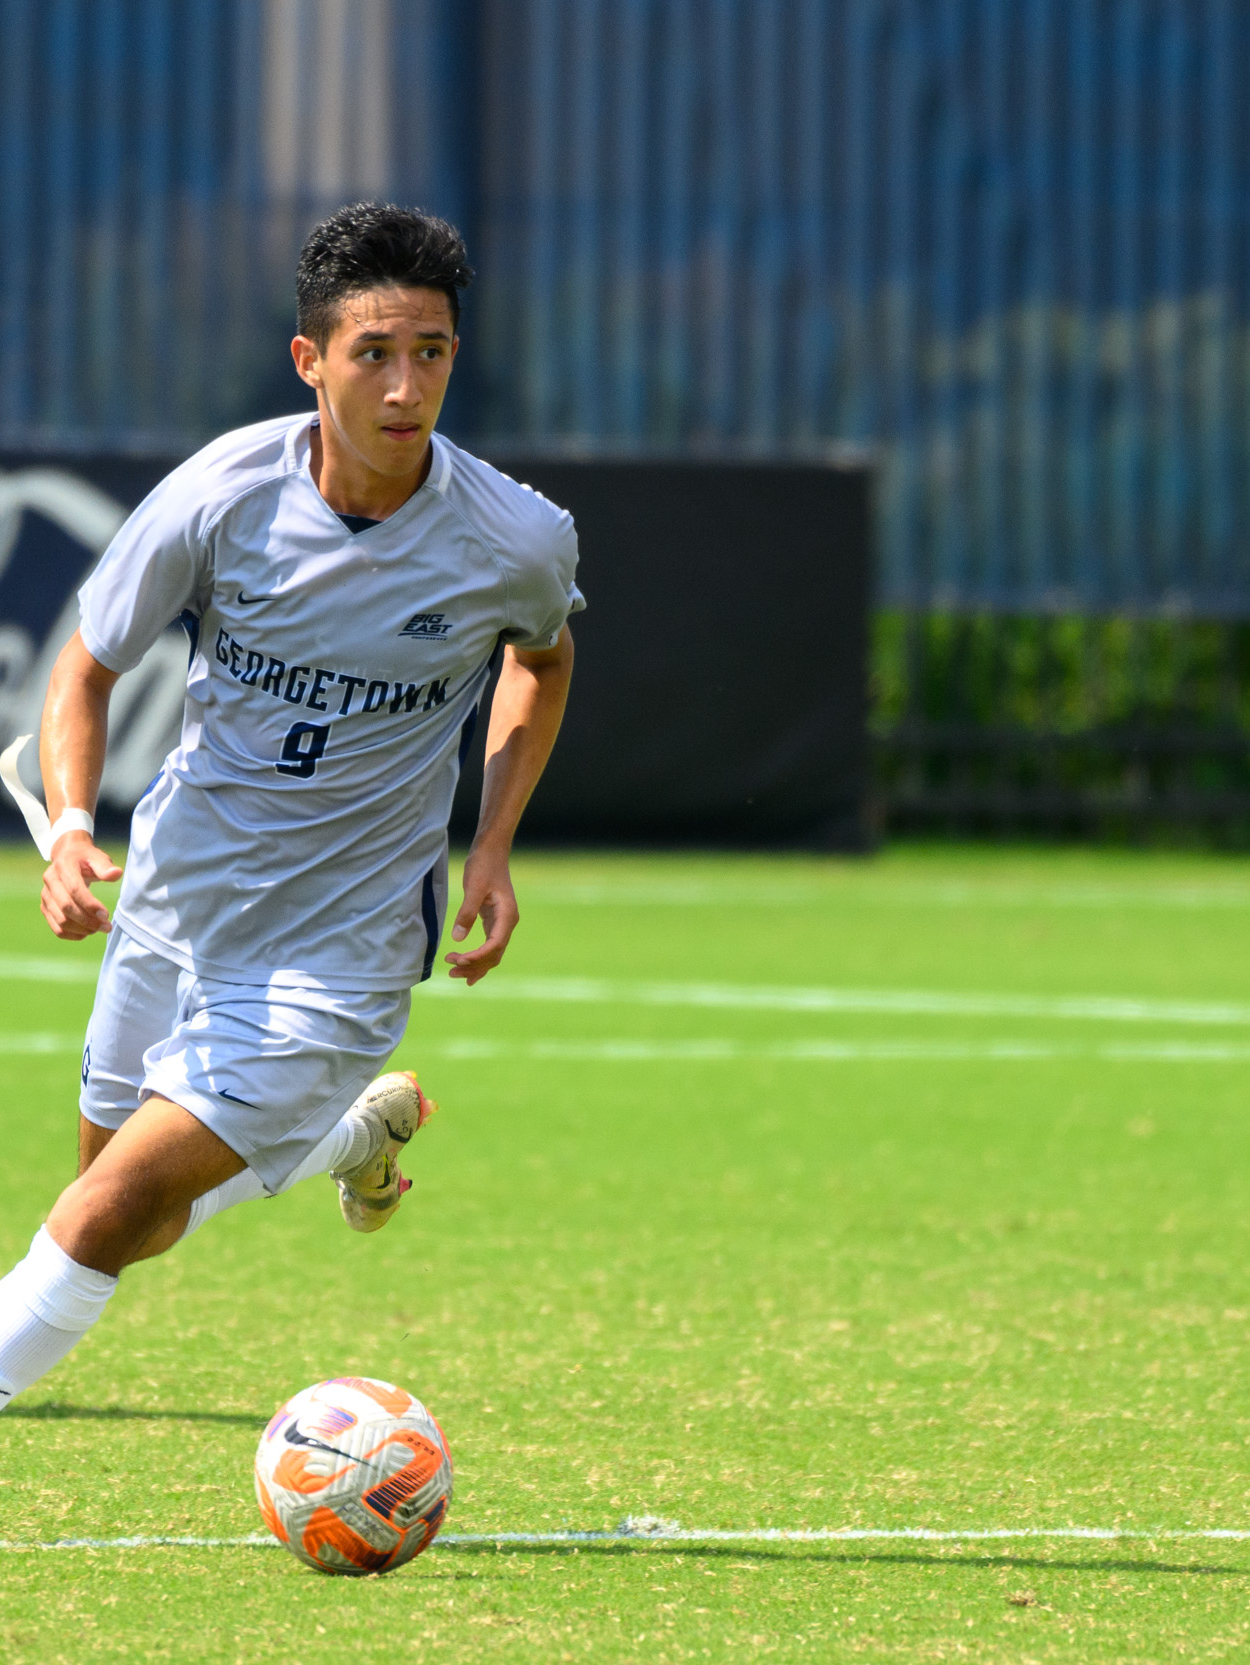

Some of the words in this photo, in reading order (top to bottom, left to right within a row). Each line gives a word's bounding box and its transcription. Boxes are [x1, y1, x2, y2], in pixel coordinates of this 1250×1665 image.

[402, 623, 453, 634] EAST
[410, 613, 446, 624] BIG
[215, 626, 451, 717] GEORGETOWN
[274, 720, 332, 781] 9
